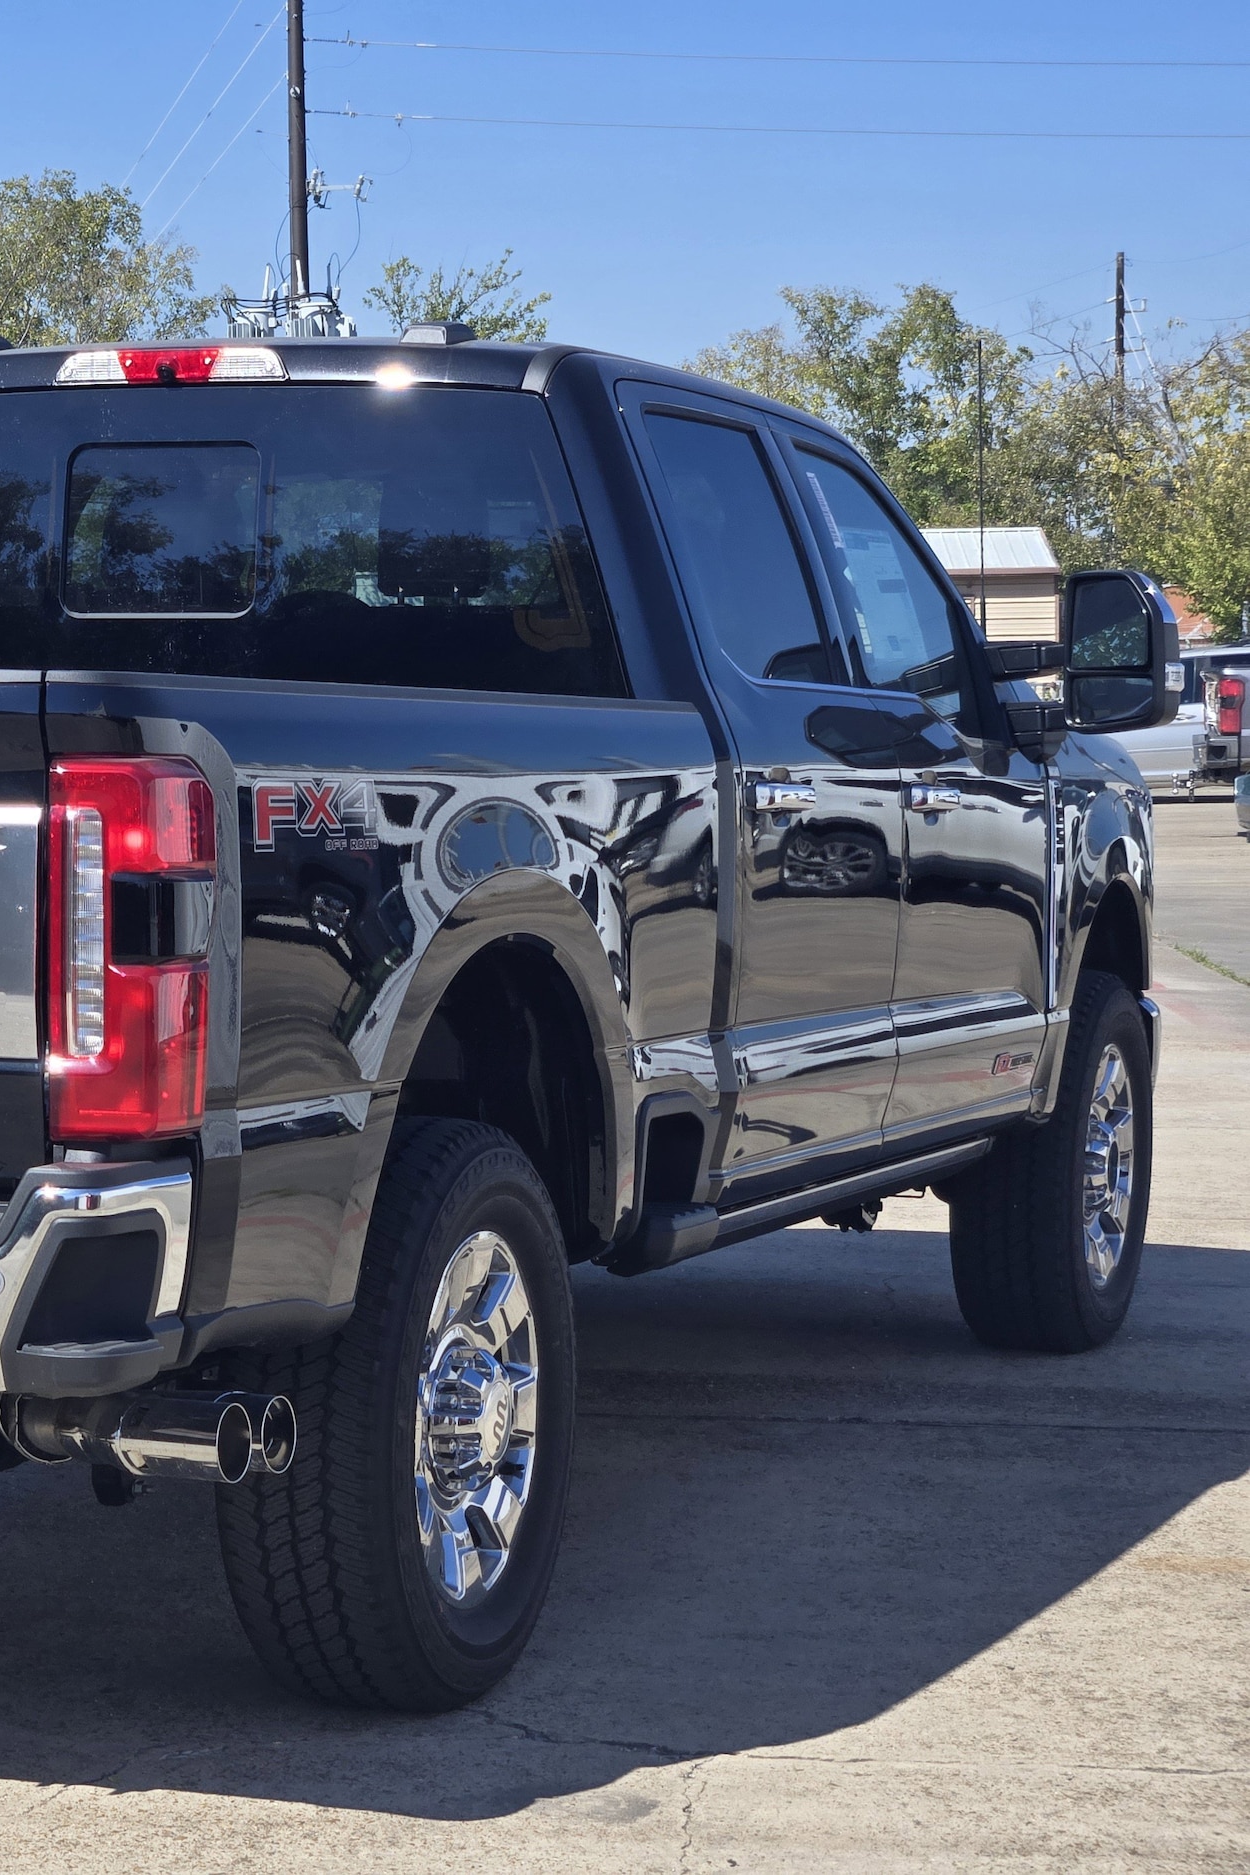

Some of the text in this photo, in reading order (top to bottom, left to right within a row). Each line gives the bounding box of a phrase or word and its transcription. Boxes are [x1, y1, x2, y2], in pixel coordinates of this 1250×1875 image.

[251, 778, 378, 852] FX4
[325, 838, 379, 851] OFF ROAD
